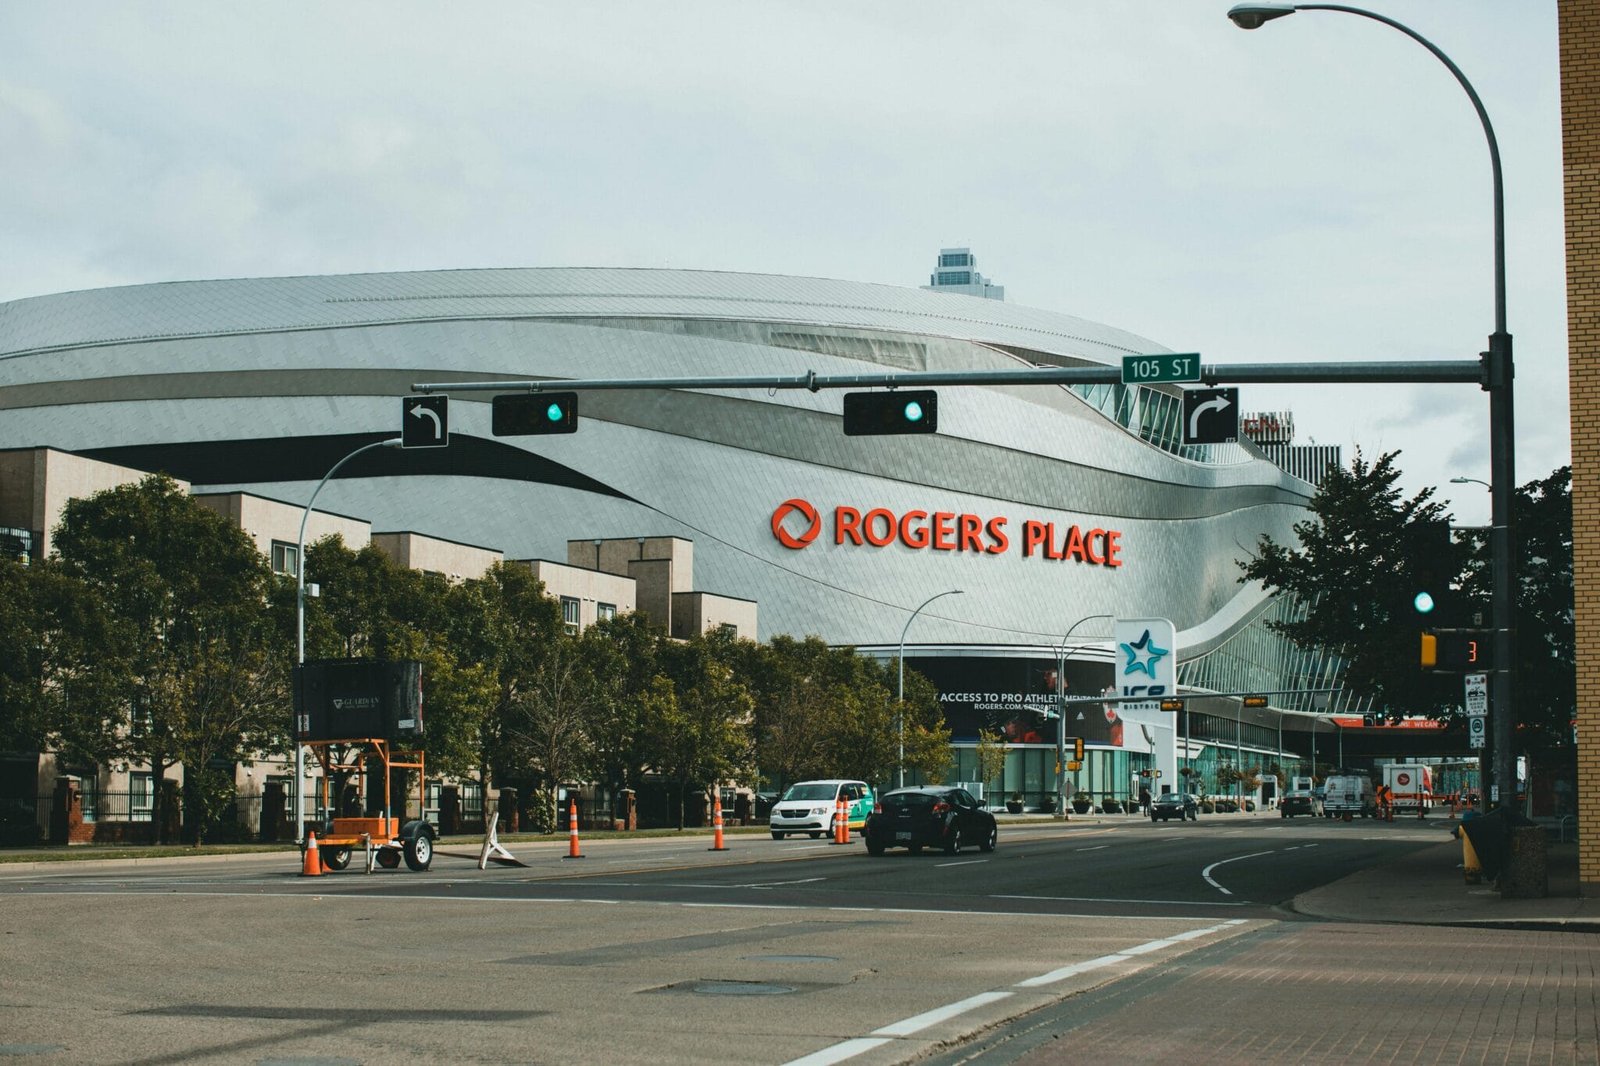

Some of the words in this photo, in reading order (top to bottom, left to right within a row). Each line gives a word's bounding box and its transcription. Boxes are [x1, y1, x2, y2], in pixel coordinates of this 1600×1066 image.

[1131, 360, 1160, 378] 105
[1172, 358, 1191, 376] ST
[834, 506, 1010, 554] ROGERS
[1023, 519, 1123, 567] PLACE
[1468, 641, 1477, 662] 3
[940, 693, 982, 702] ACCESS
[983, 693, 999, 702] TO
[1001, 693, 1023, 702] PRO
[1025, 693, 1058, 703] ATHLET
